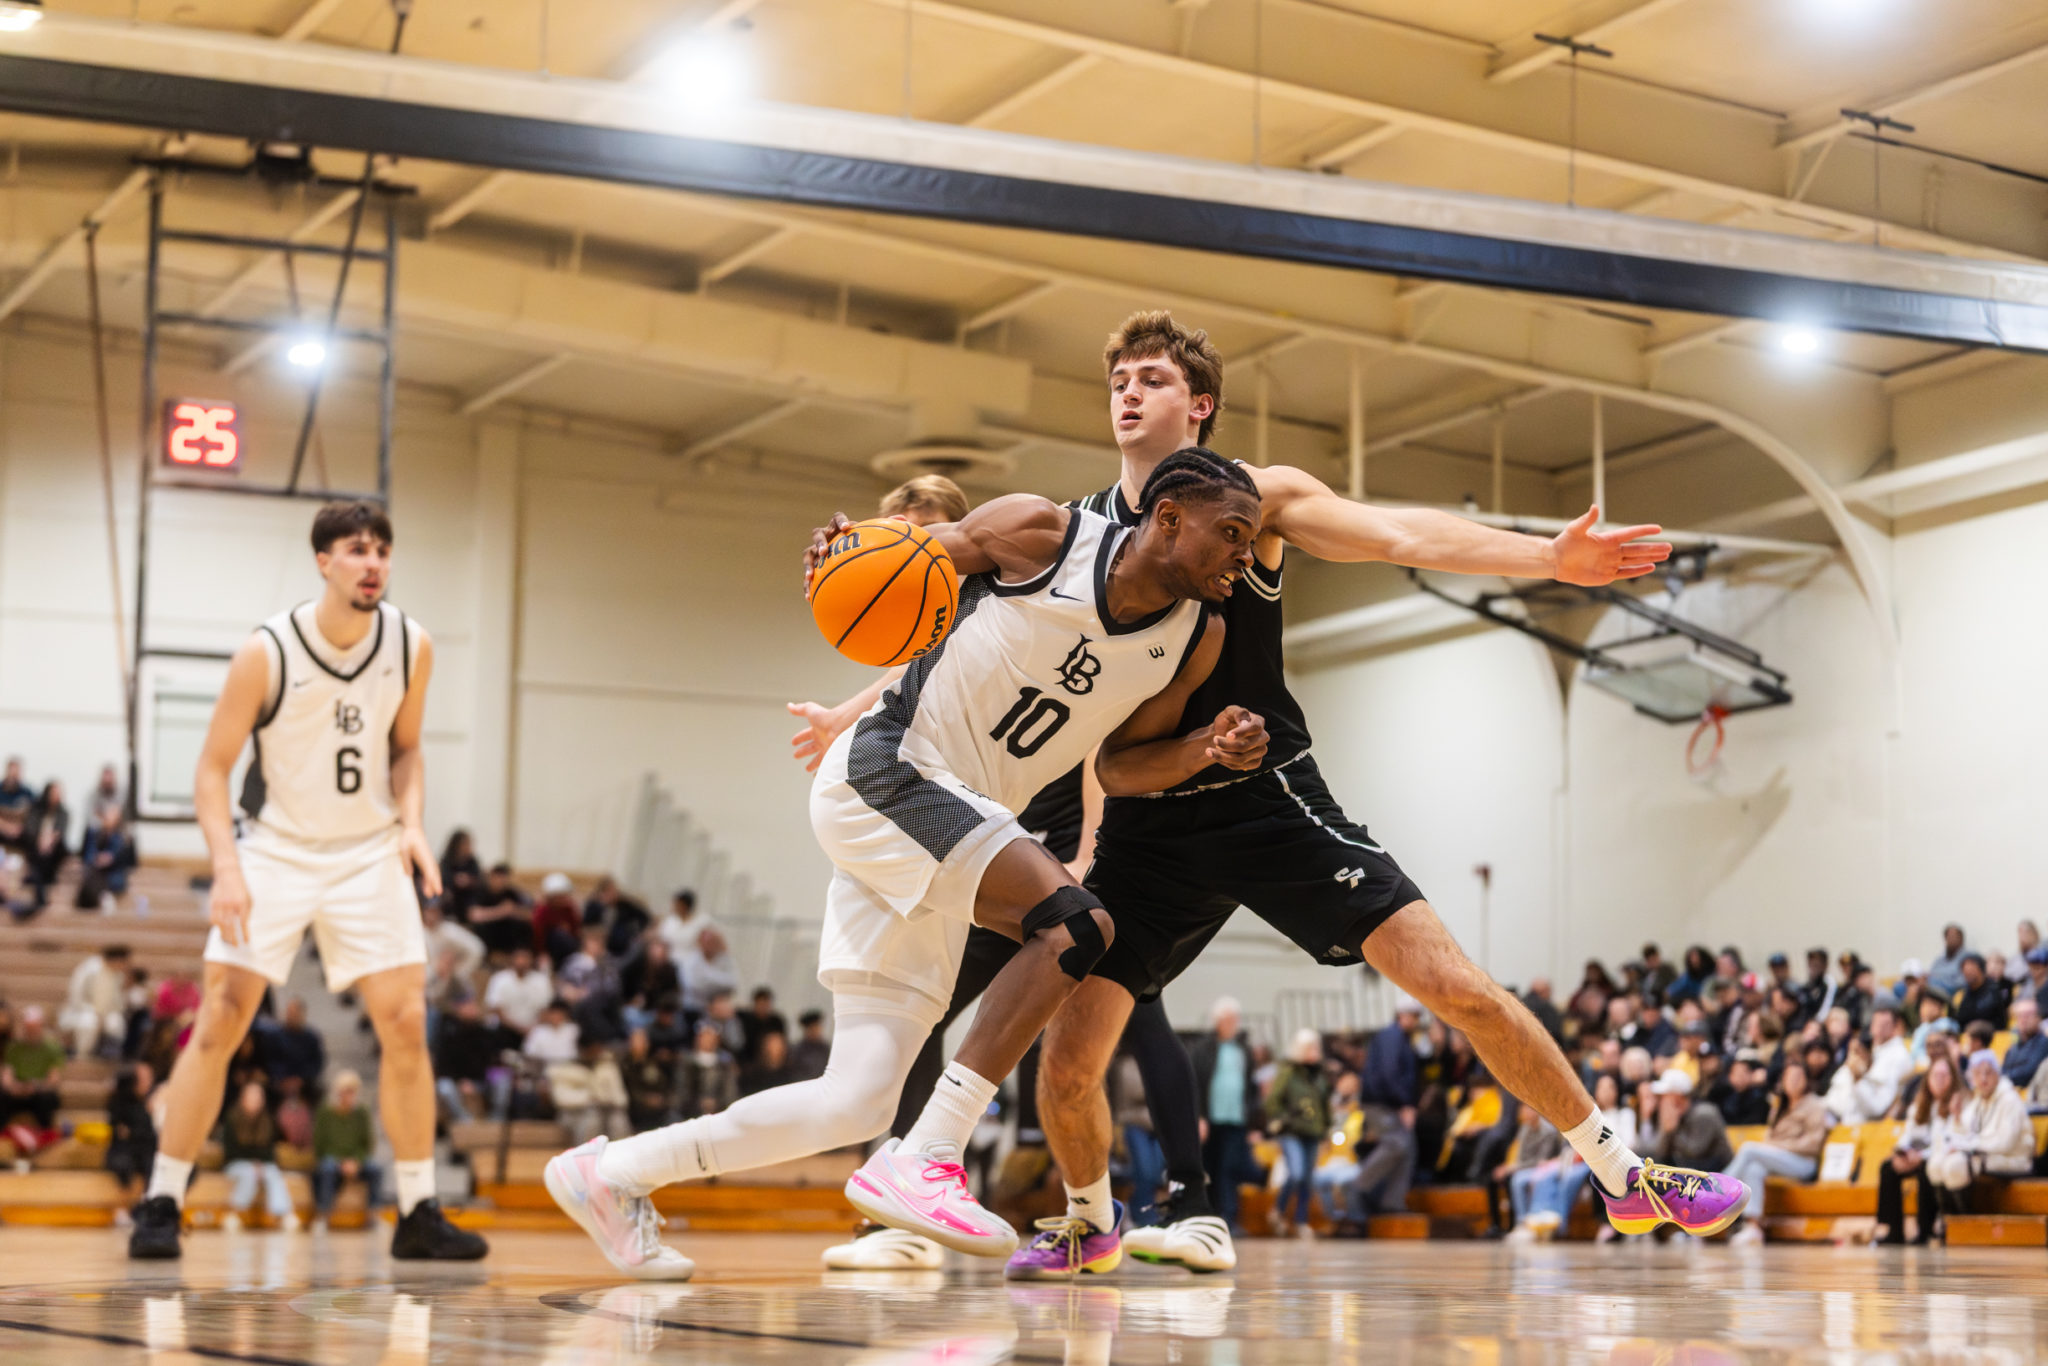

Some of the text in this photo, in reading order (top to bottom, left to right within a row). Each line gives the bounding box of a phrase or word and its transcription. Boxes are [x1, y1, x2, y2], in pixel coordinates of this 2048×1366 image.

[168, 403, 239, 467] 25
[1053, 633, 1102, 695] LB
[335, 699, 364, 735] LB
[989, 686, 1071, 760] 10
[336, 746, 363, 795] 6
